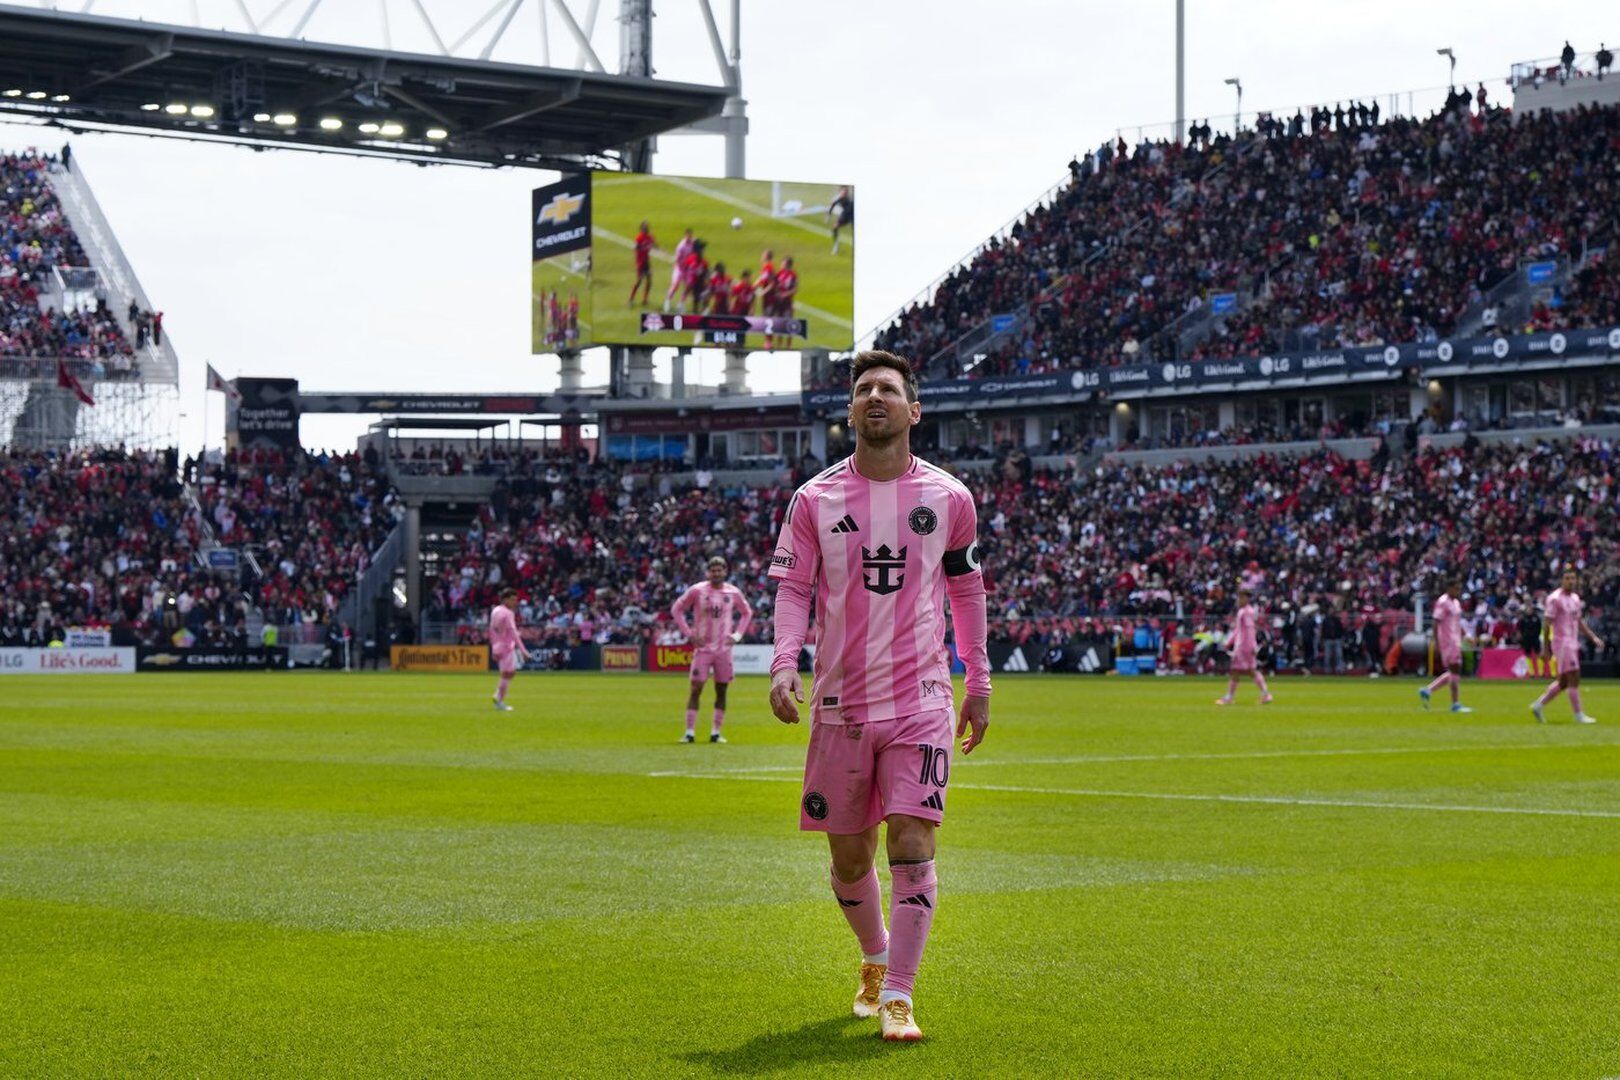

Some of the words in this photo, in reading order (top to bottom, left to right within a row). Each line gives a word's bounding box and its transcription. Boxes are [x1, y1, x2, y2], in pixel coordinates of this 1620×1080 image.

[536, 226, 586, 248] CHEVROLET
[673, 315, 683, 331] 0
[765, 318, 774, 335] 2
[1176, 364, 1192, 379] LG
[1273, 357, 1290, 373] LG
[1084, 372, 1100, 386] LG
[402, 401, 481, 409] CHEVROLET
[241, 407, 288, 420] Together
[240, 420, 263, 430] let's
[264, 420, 293, 430] drive
[4, 653, 23, 668] LG
[40, 652, 76, 669] Life's
[79, 652, 122, 668] Good.
[398, 648, 450, 666] Continental
[458, 648, 483, 666] Tire
[918, 743, 949, 788] 10
